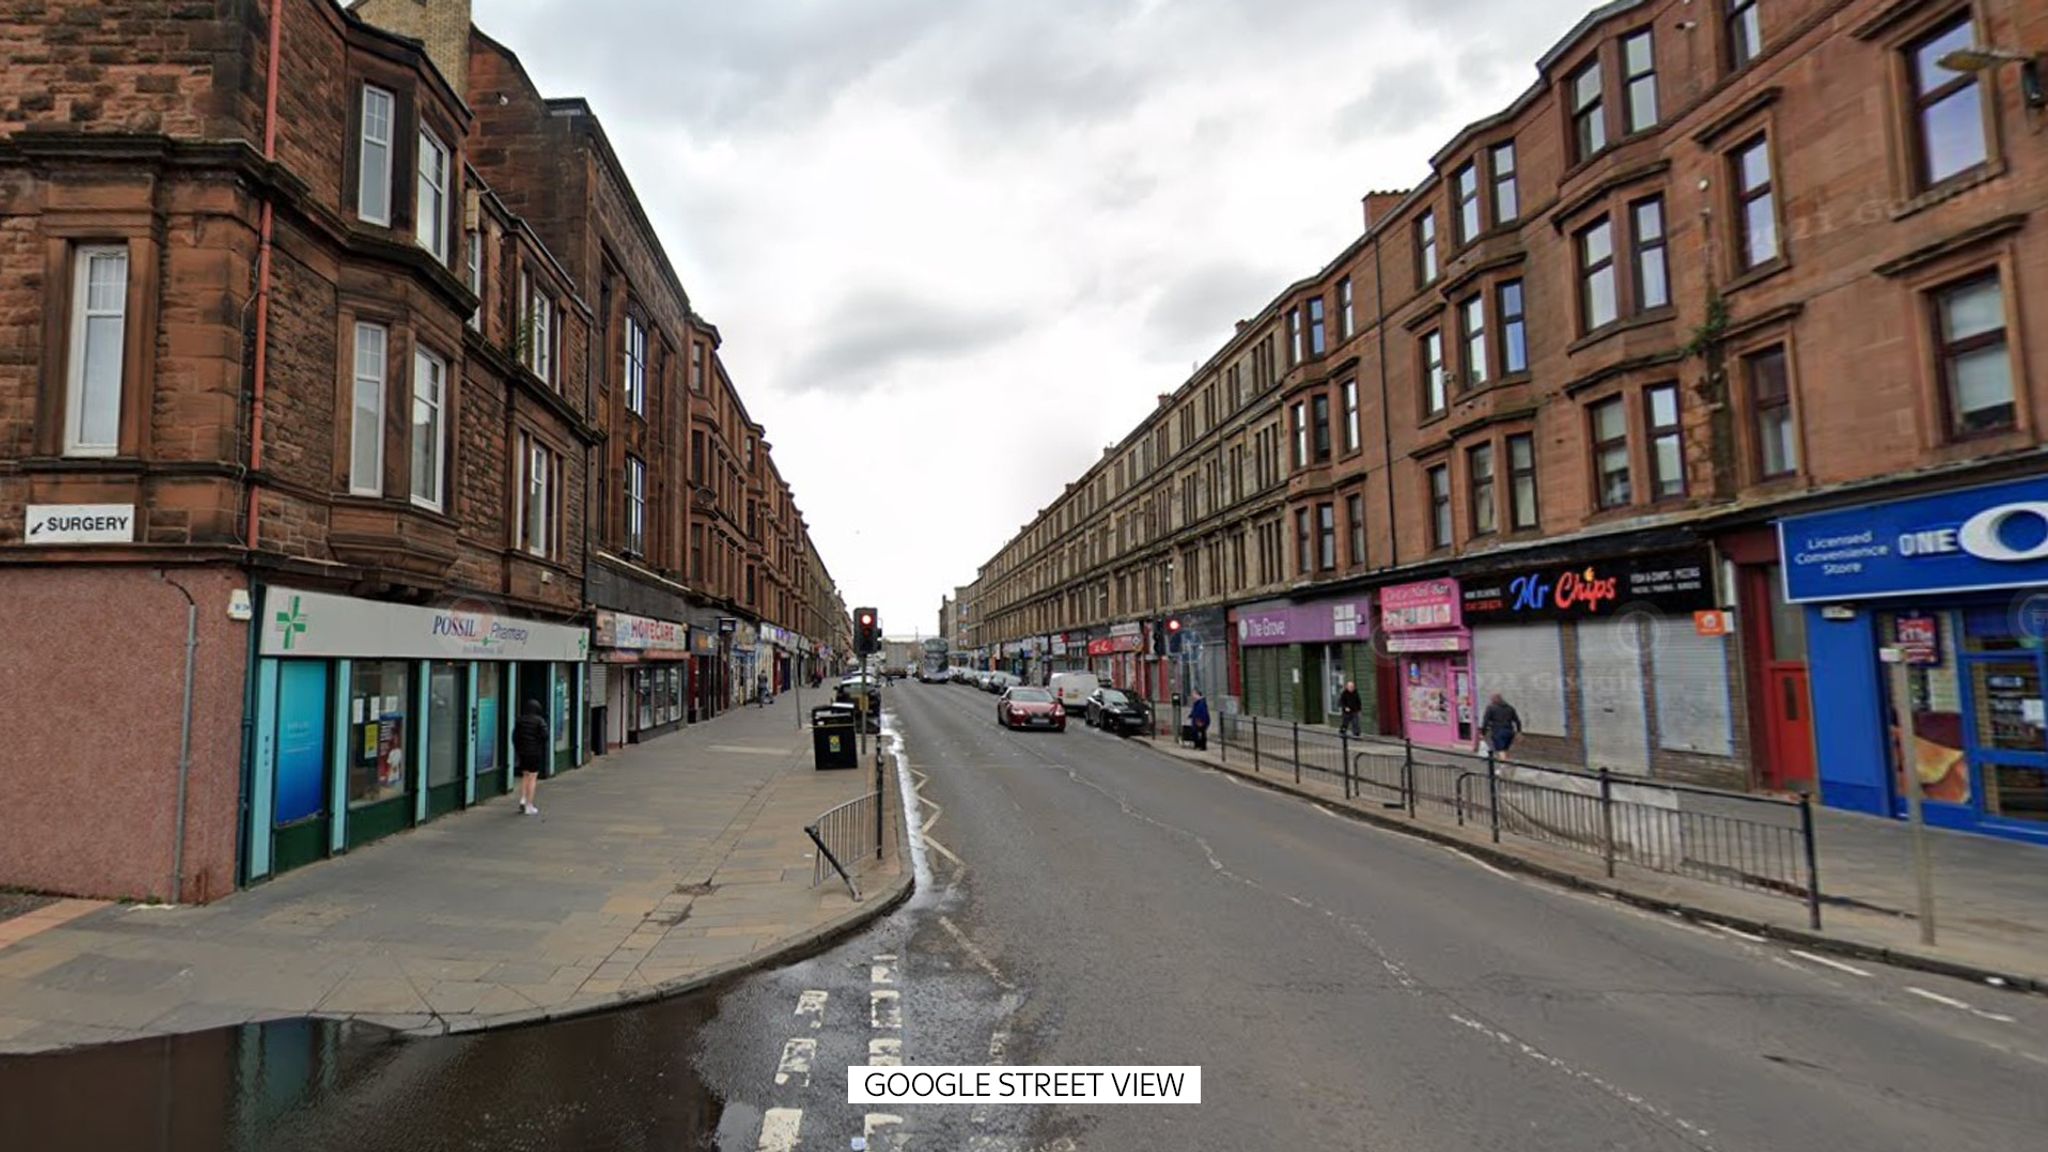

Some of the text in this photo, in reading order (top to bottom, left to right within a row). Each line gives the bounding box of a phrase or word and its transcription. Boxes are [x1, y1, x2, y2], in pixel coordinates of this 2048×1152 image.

[46, 516, 129, 532] SURGERY
[1807, 530, 1873, 550] Licensed
[1899, 528, 1958, 557] ONE
[1794, 545, 1889, 566] Convenience
[1821, 563, 1862, 576] Store
[1509, 570, 1617, 612] Mr Chips
[432, 615, 530, 645] POSSIL Pharmacy
[630, 617, 675, 642] HOMECARE
